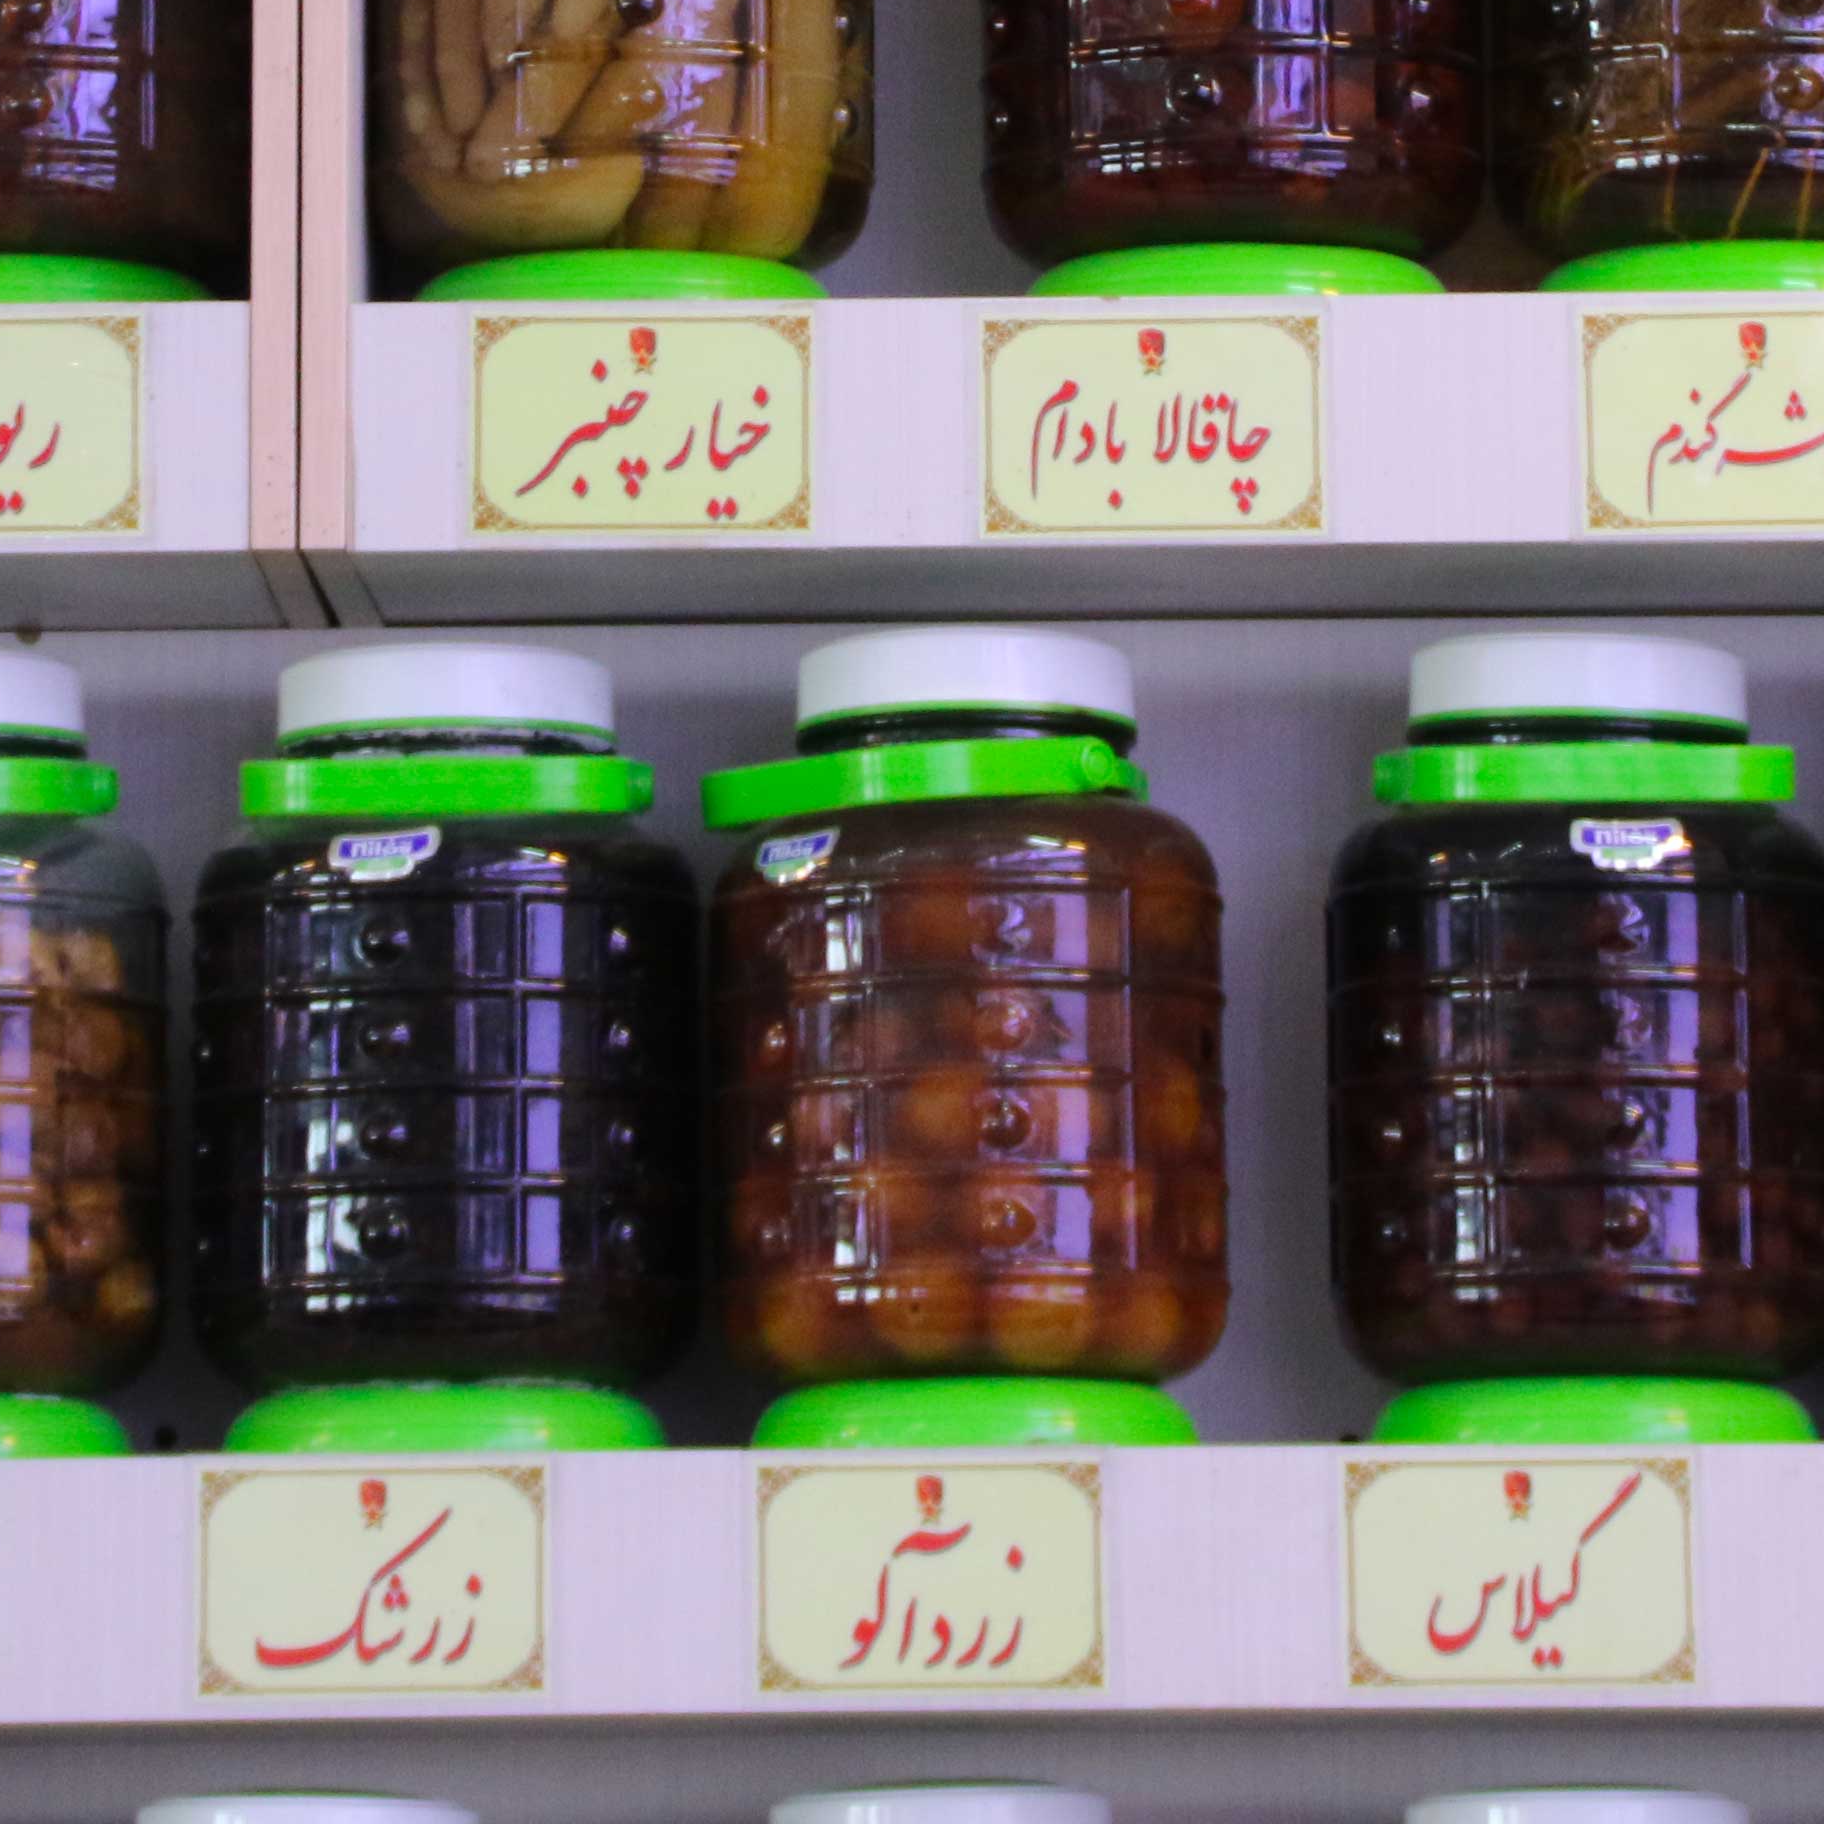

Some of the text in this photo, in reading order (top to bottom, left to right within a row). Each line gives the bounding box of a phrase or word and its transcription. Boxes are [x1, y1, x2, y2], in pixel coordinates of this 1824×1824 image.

[516, 360, 773, 522] خیار چنبر
[1030, 379, 1127, 510] بادام
[254, 1509, 486, 1671] زرشک
[839, 1523, 1027, 1670] زردآلو
[1425, 1471, 1644, 1670] گیلاس
